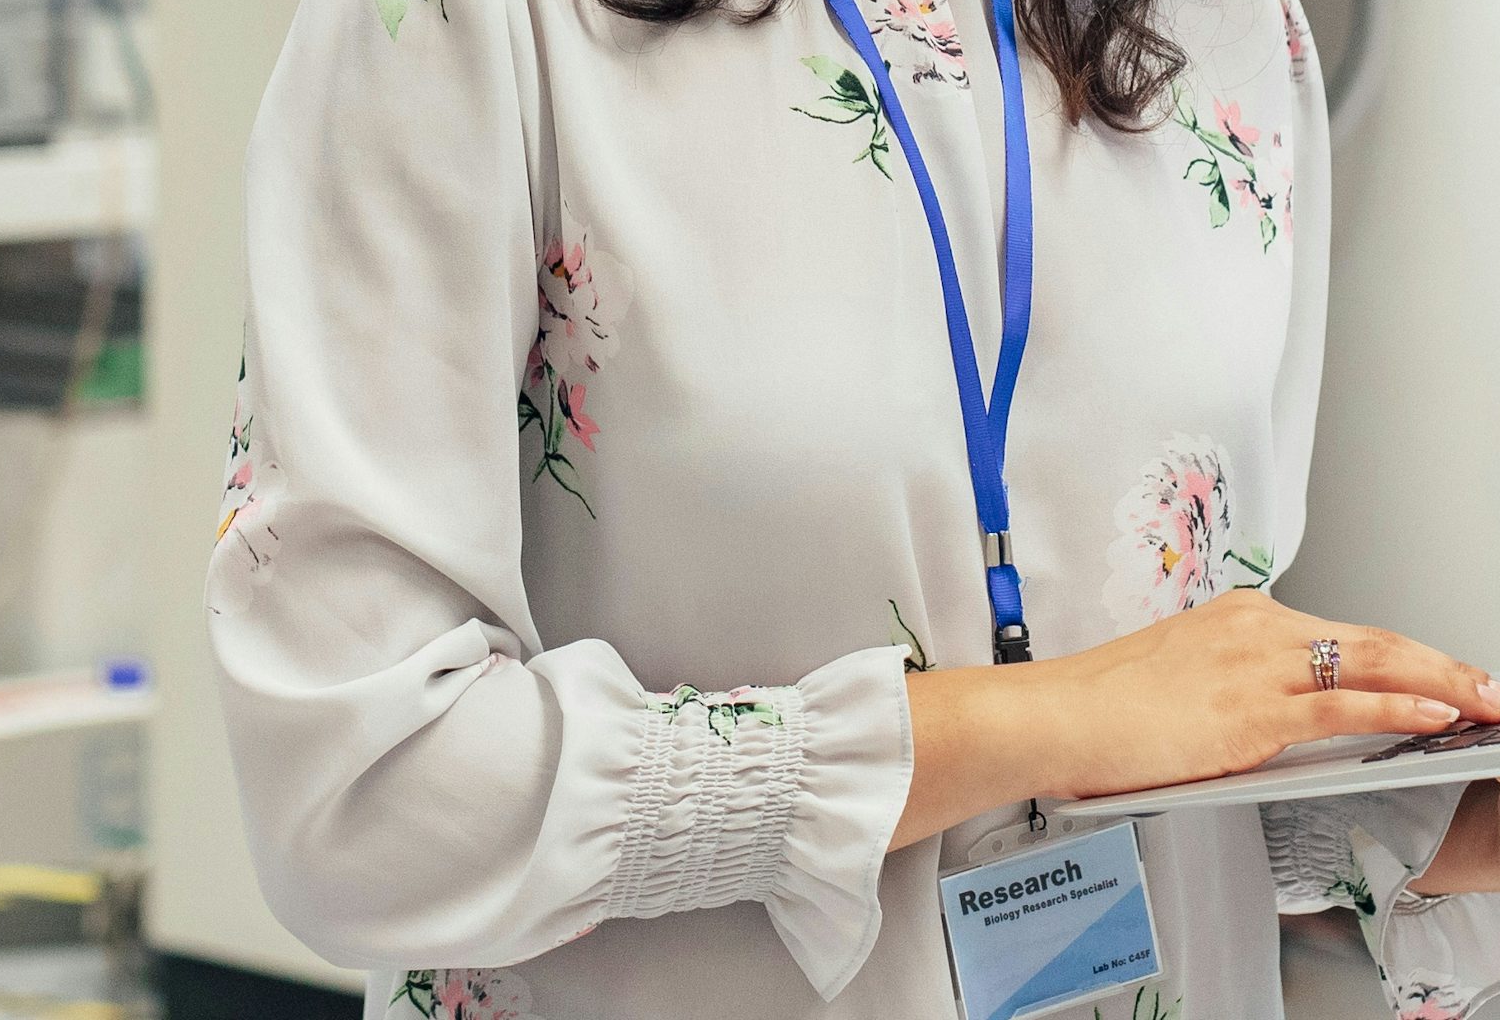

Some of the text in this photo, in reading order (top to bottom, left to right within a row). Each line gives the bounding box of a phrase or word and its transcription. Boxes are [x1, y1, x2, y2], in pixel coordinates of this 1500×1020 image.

[958, 860, 1083, 916] Research
[984, 877, 1119, 927] Biology Research Specialist
[1092, 963, 1109, 975] Lab
[1111, 958, 1126, 969] No:
